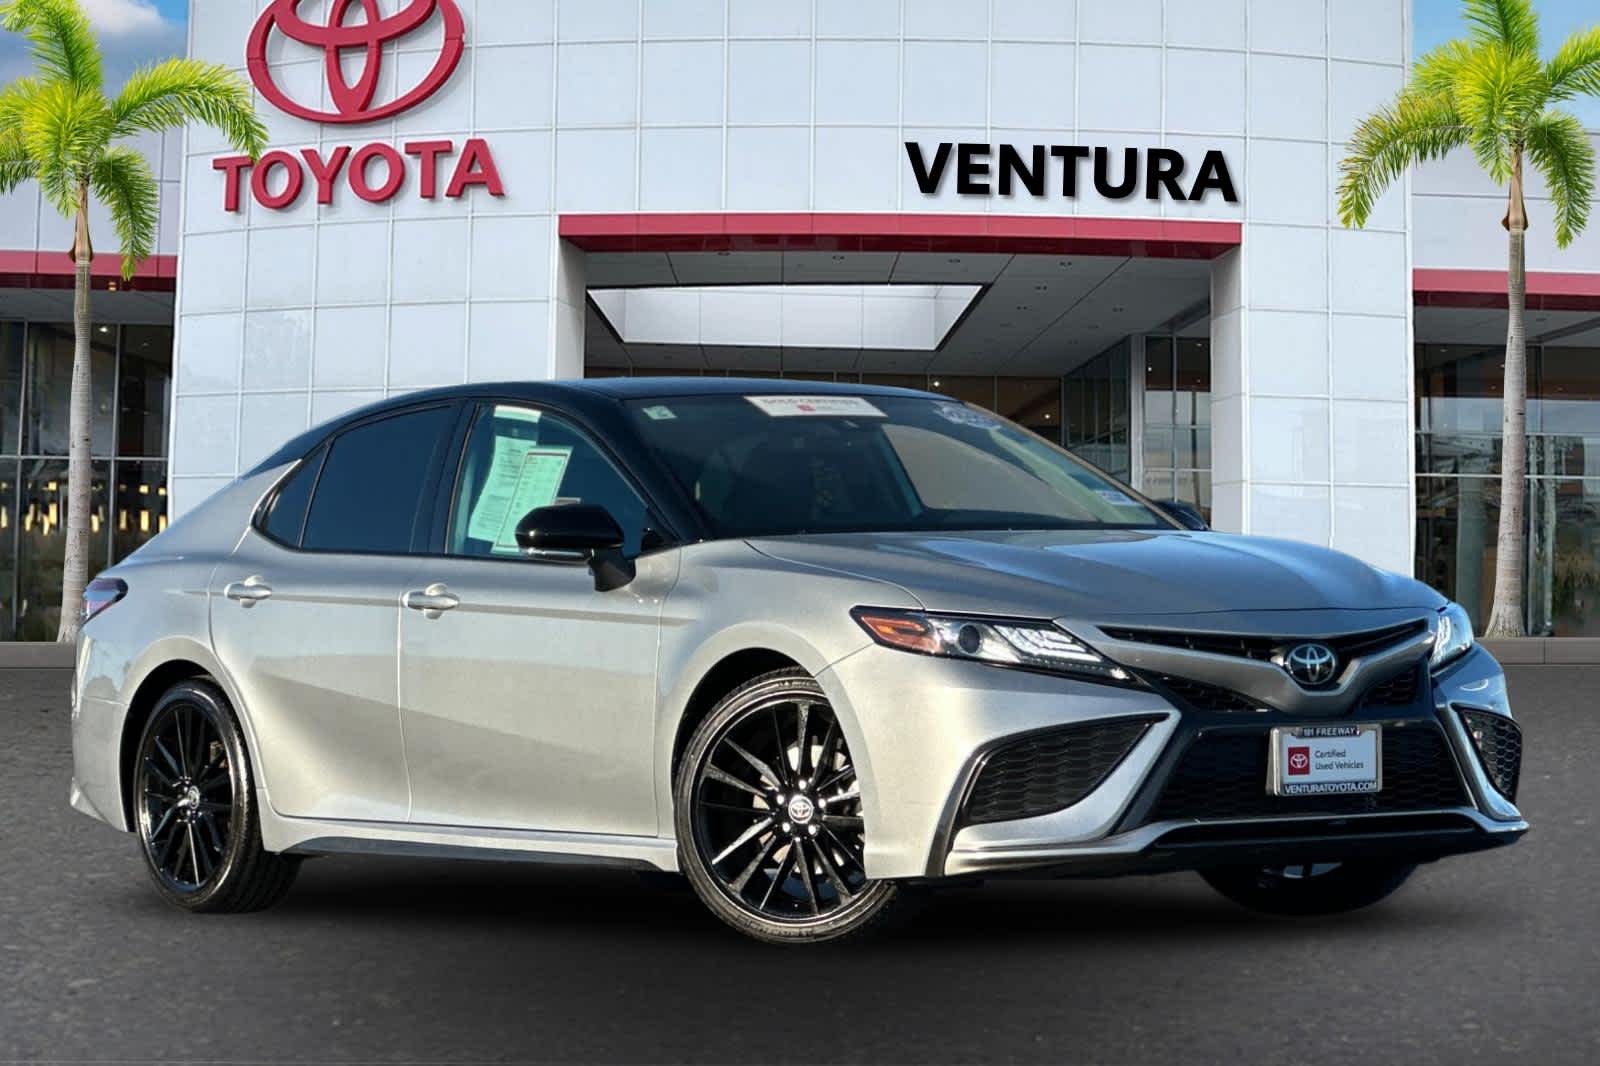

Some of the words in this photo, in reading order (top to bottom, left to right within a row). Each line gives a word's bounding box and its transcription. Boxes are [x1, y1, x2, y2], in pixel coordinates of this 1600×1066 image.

[212, 138, 505, 212] TOYOTA
[904, 142, 1238, 203] VENTURA
[1316, 727, 1355, 736] FREEWAY
[1315, 750, 1346, 758] Certified
[1315, 762, 1334, 770] Used
[1335, 761, 1364, 769] Vehicles
[1285, 782, 1376, 794] VENTURATOYOTA.COM
